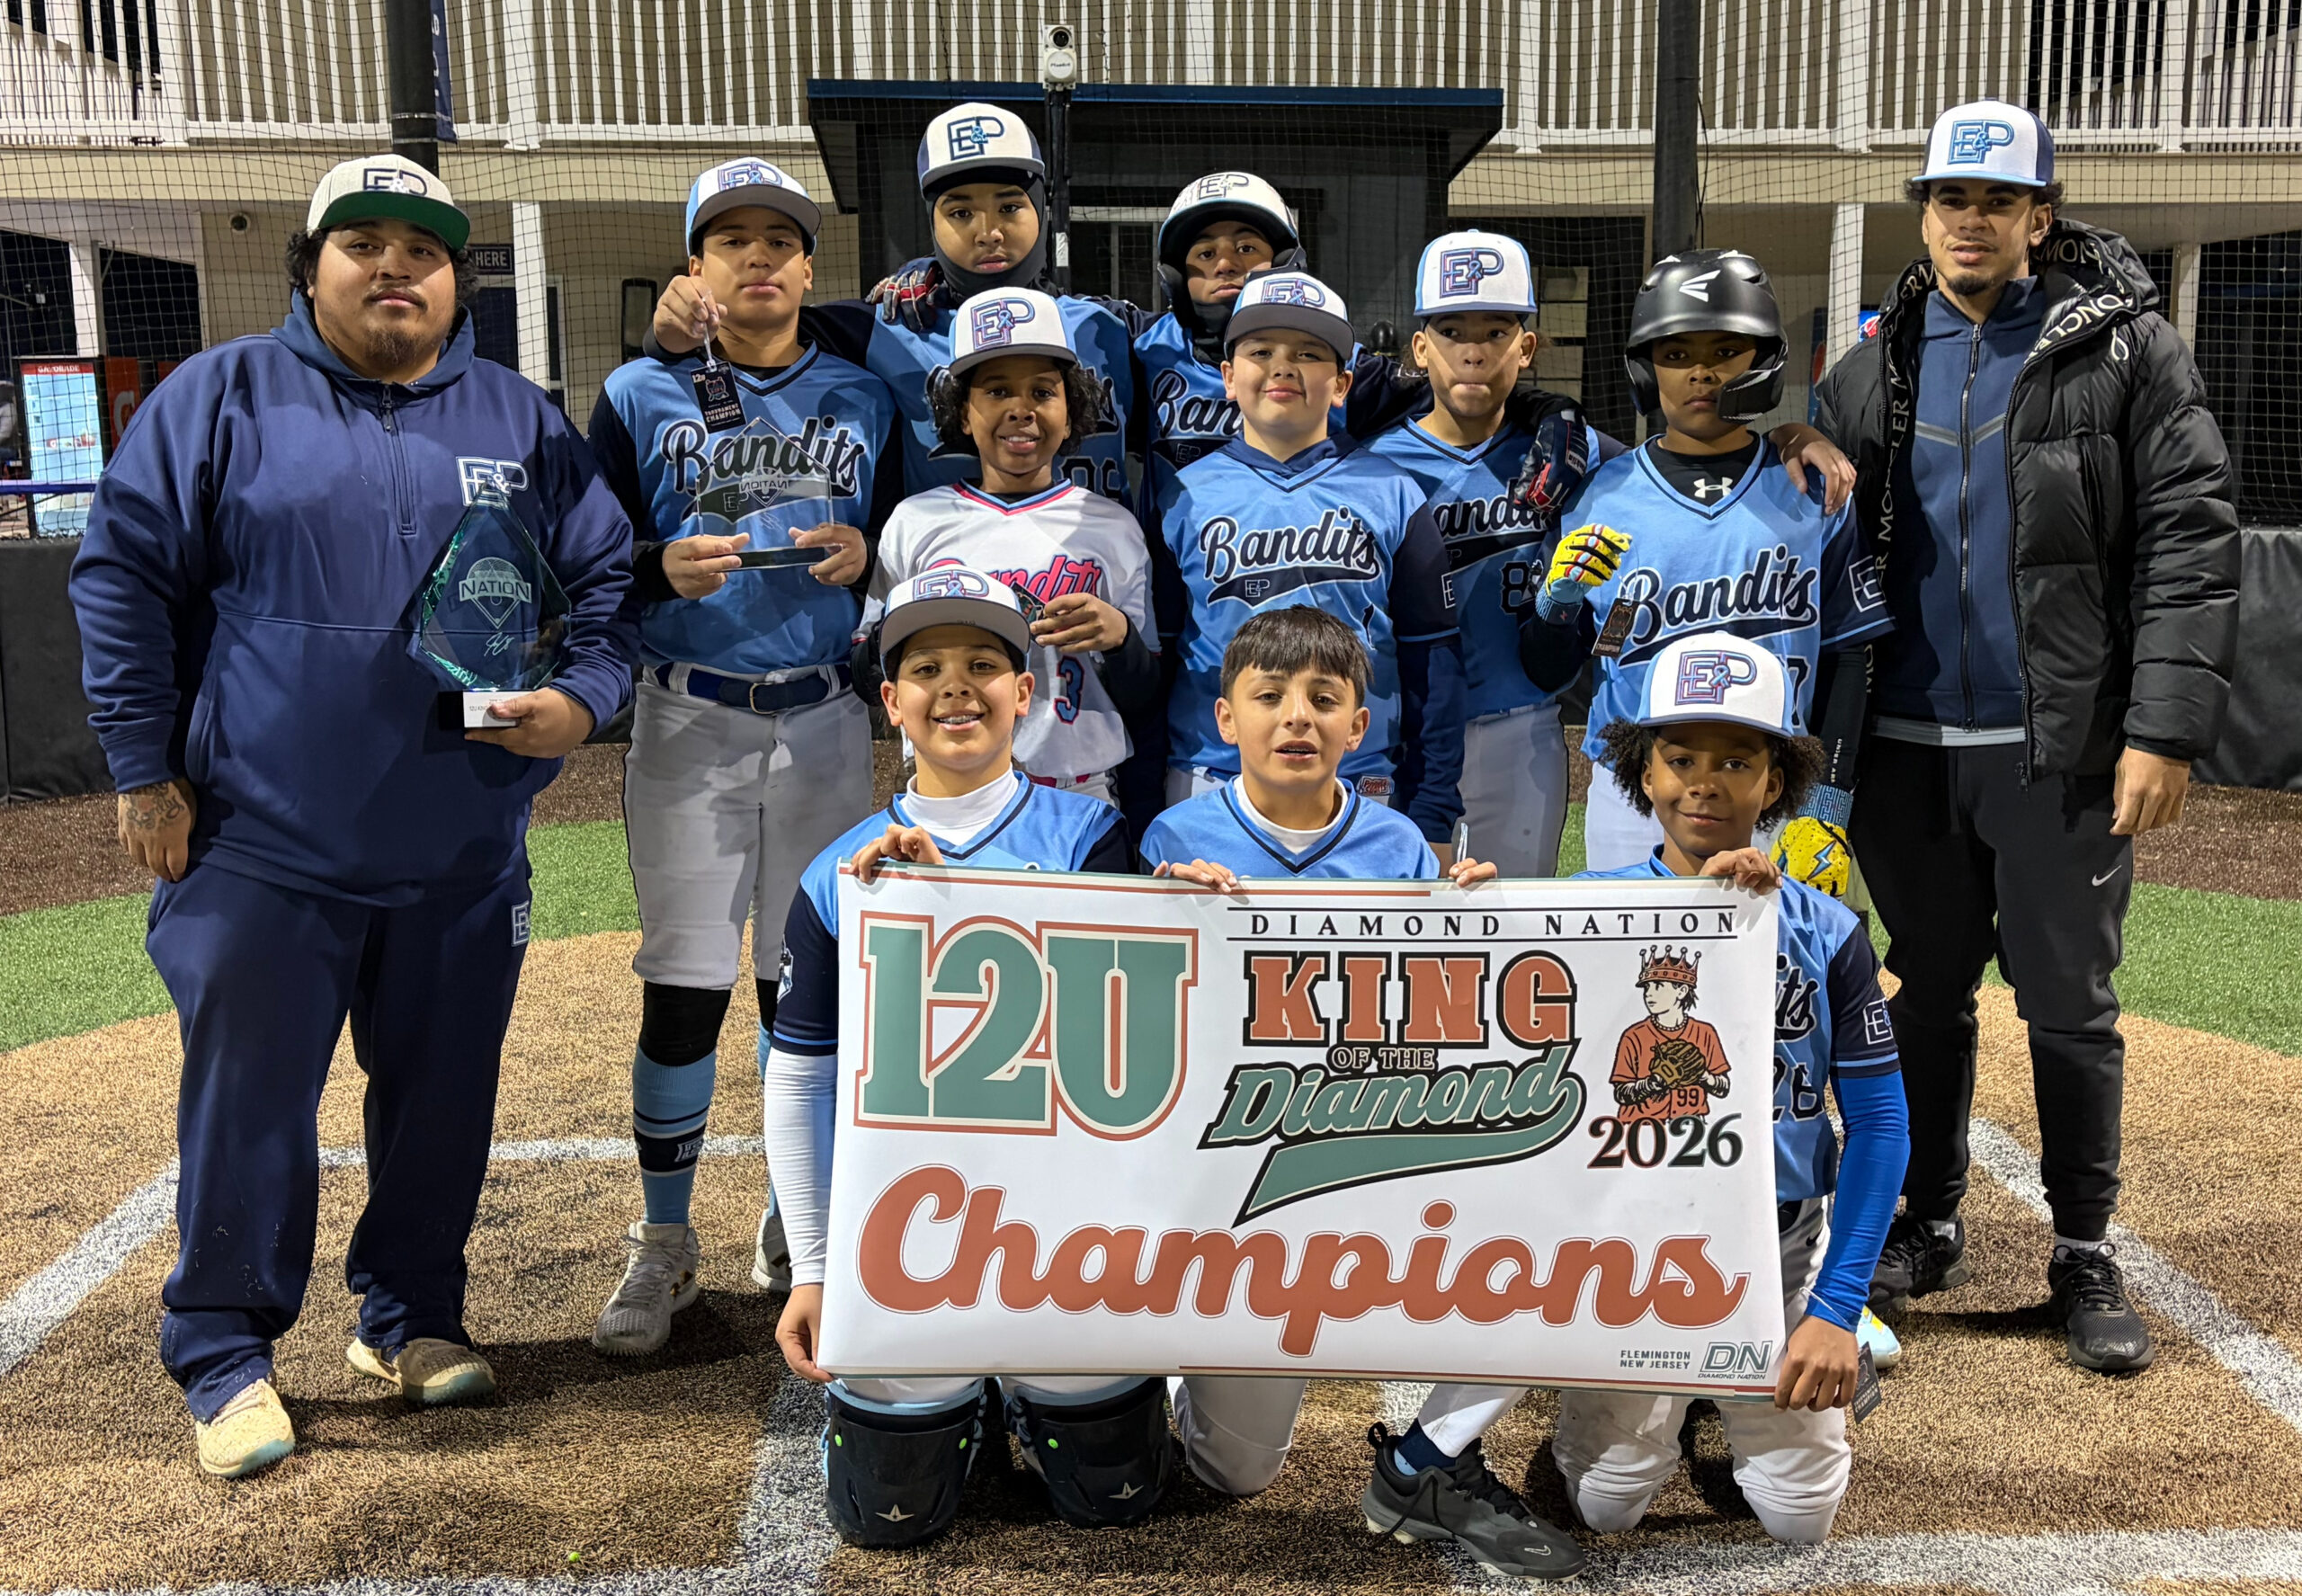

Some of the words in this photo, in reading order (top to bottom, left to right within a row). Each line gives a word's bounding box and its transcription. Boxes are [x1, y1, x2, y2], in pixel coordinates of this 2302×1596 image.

[475, 250, 508, 267] HERE
[38, 365, 80, 373] GAORADE
[706, 408, 742, 423] CHAMPION
[661, 415, 865, 497] Bandits
[1200, 505, 1378, 584] Bandits
[461, 579, 531, 601] NATION
[1619, 543, 1817, 646] Bandits
[1054, 655, 1084, 725] 3
[1251, 914, 1500, 937] DIAMOND
[1545, 911, 1736, 936] NATION
[1243, 949, 1577, 1050] KING
[853, 910, 1199, 1141] 12U
[1331, 1047, 1370, 1068] OF
[1379, 1048, 1436, 1070] THE
[1197, 1038, 1586, 1152] Diamond
[1676, 1088, 1700, 1107] 99
[1587, 1113, 1743, 1169] 2026
[856, 1163, 1751, 1358] Champions
[1619, 1350, 1691, 1360] FLEMINGTON
[1619, 1360, 1646, 1369] NEW
[1649, 1360, 1691, 1370] JERSEY
[1700, 1340, 1772, 1374] DN
[1736, 1373, 1766, 1381] NATION
